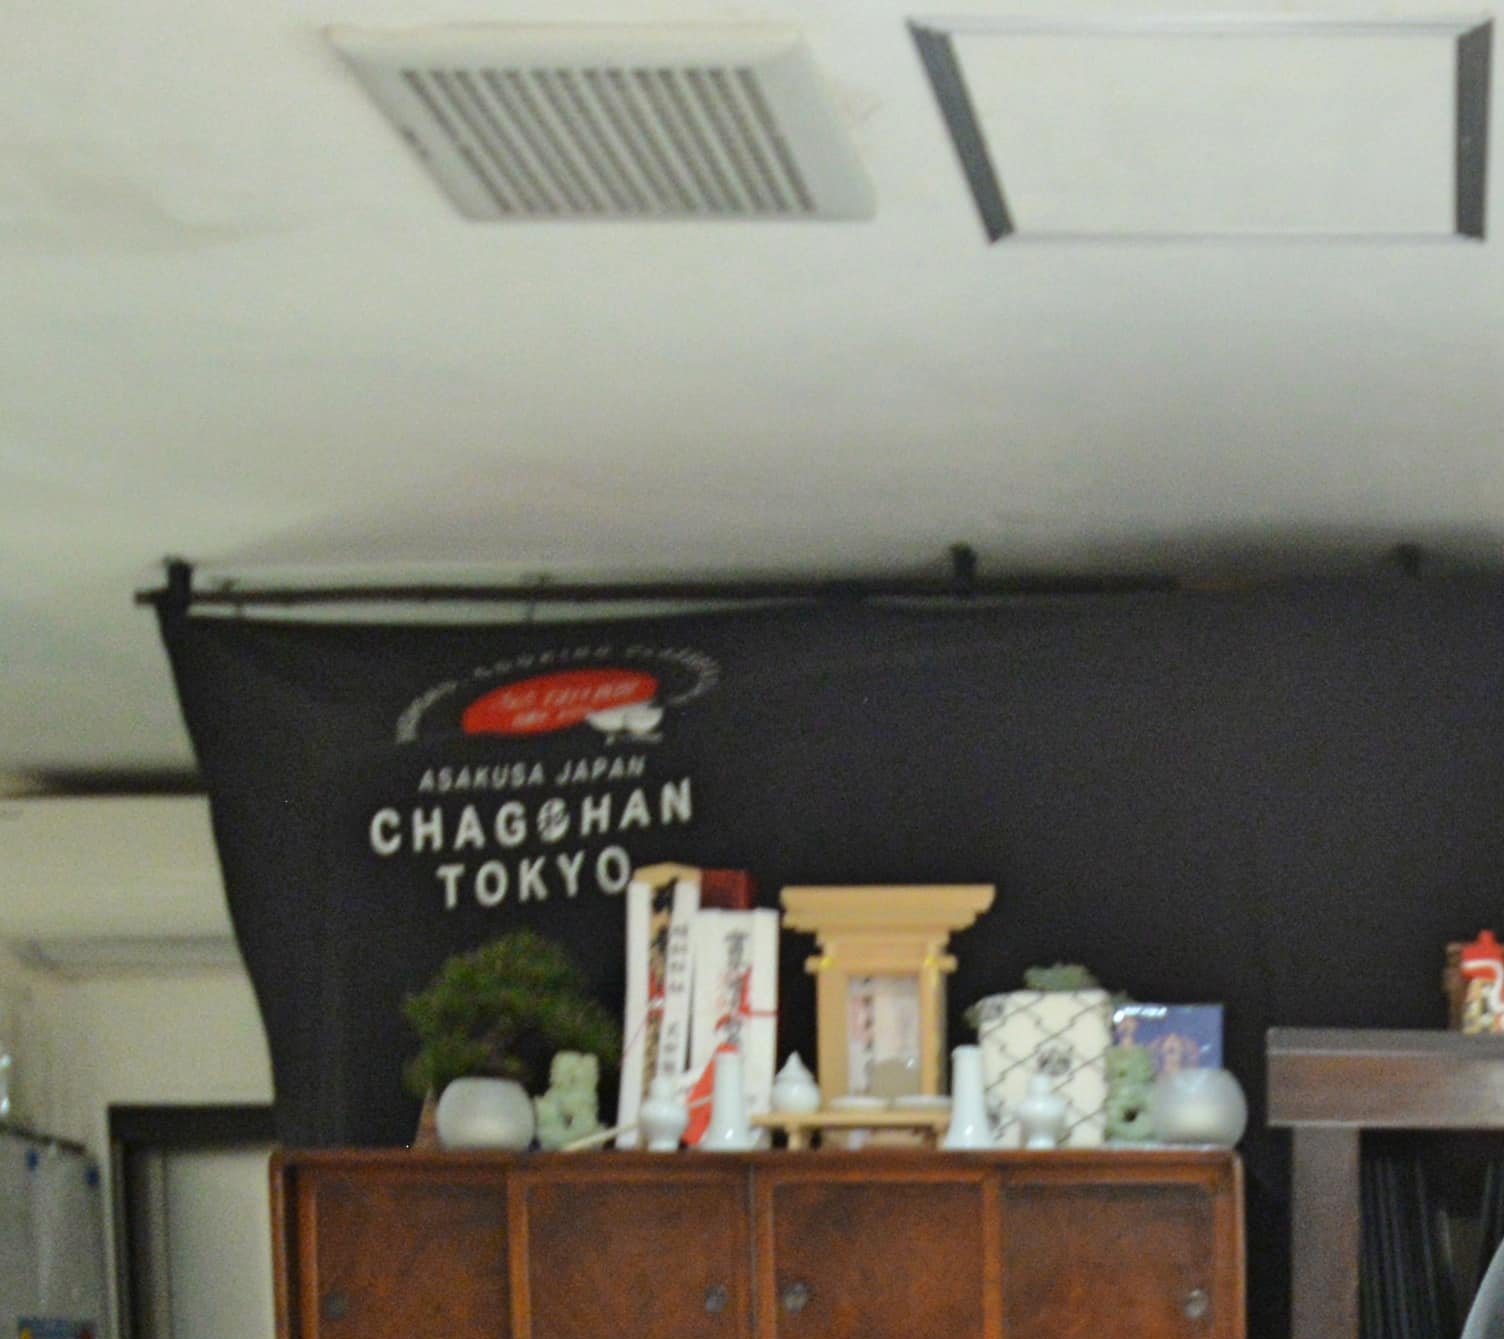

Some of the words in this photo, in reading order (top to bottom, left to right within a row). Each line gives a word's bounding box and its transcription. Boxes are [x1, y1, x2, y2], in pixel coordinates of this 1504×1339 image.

[418, 761, 545, 793] ASAKUSA
[555, 755, 647, 786] JAPAN
[436, 845, 631, 910] TOKYO
